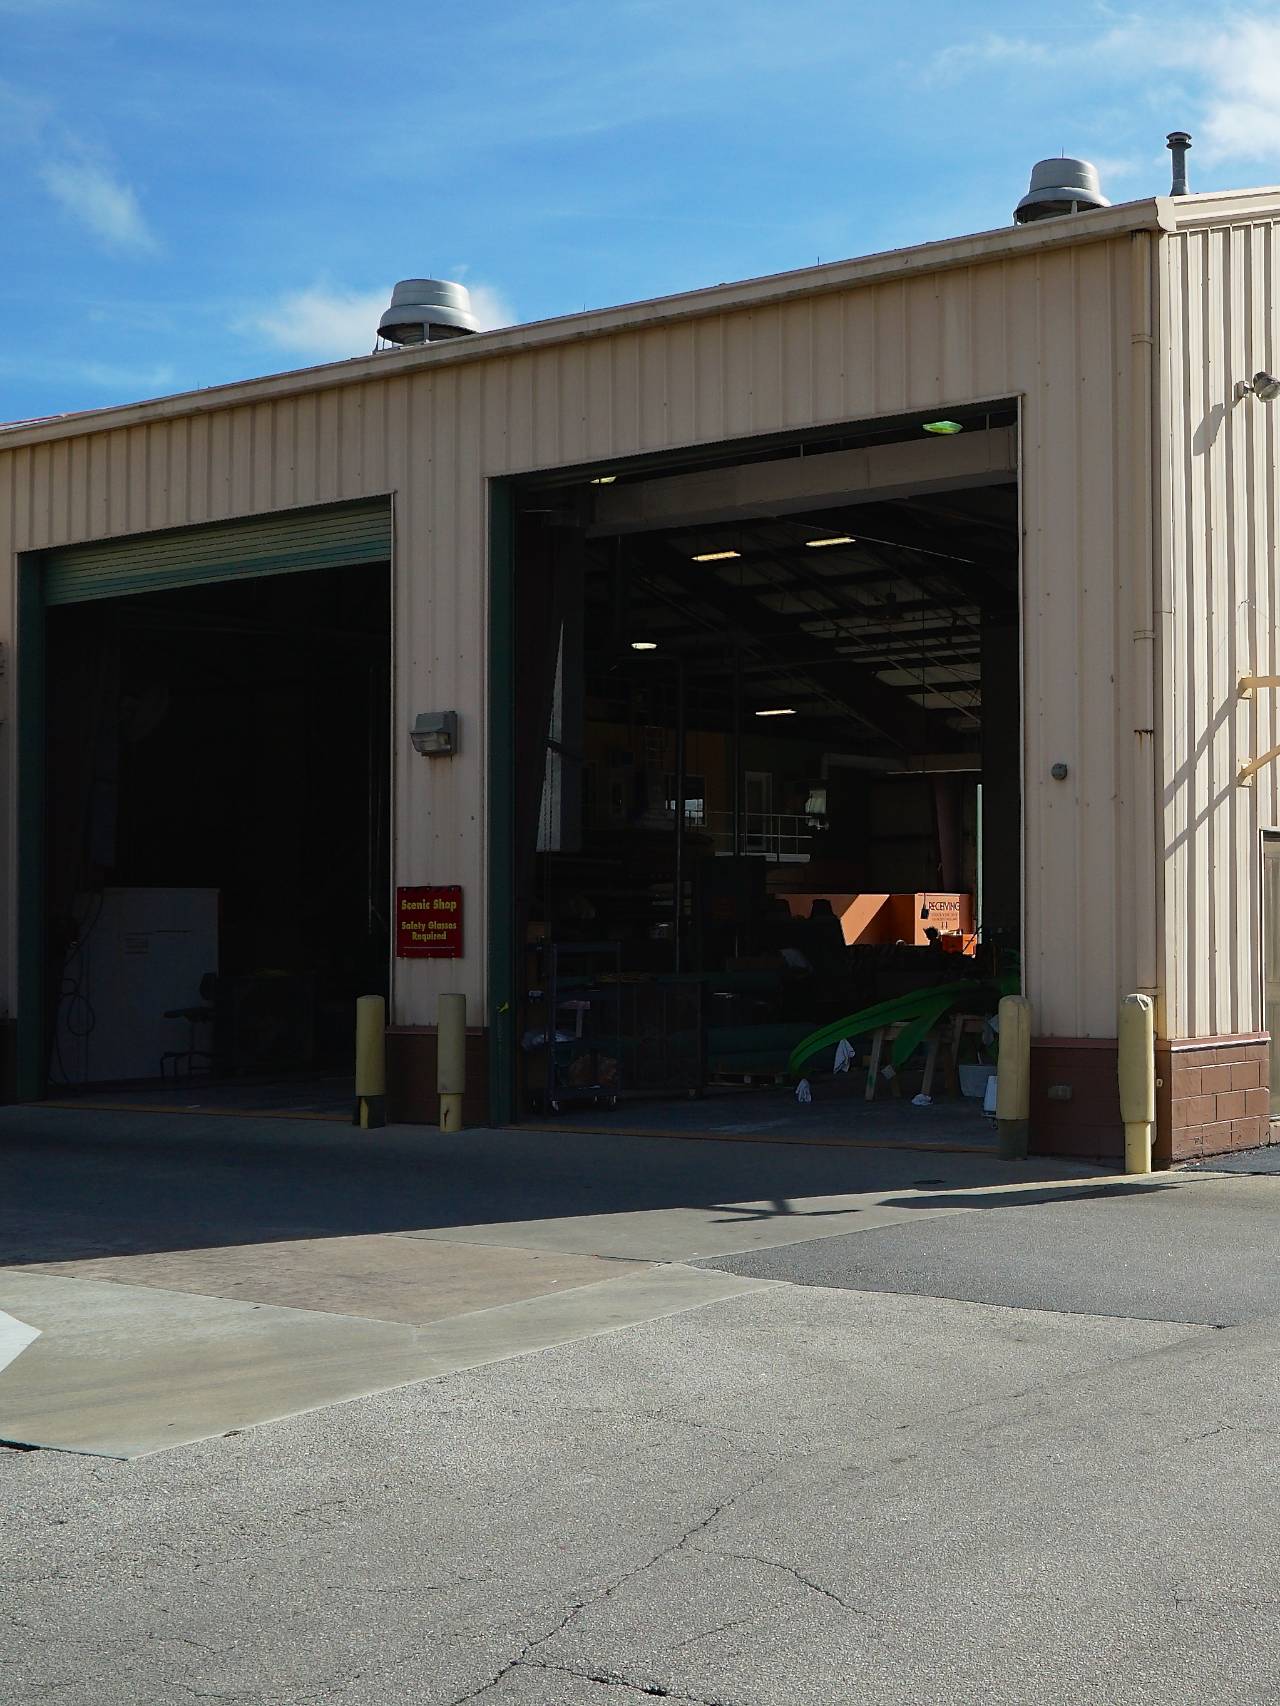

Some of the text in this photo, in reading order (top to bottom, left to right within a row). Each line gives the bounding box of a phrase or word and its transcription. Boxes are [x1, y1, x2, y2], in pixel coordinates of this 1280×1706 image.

[401, 898, 457, 912] Scenic Shop
[928, 901, 960, 911] RECEIVING
[401, 920, 457, 932] Safety Glasses
[411, 931, 447, 942] Required
